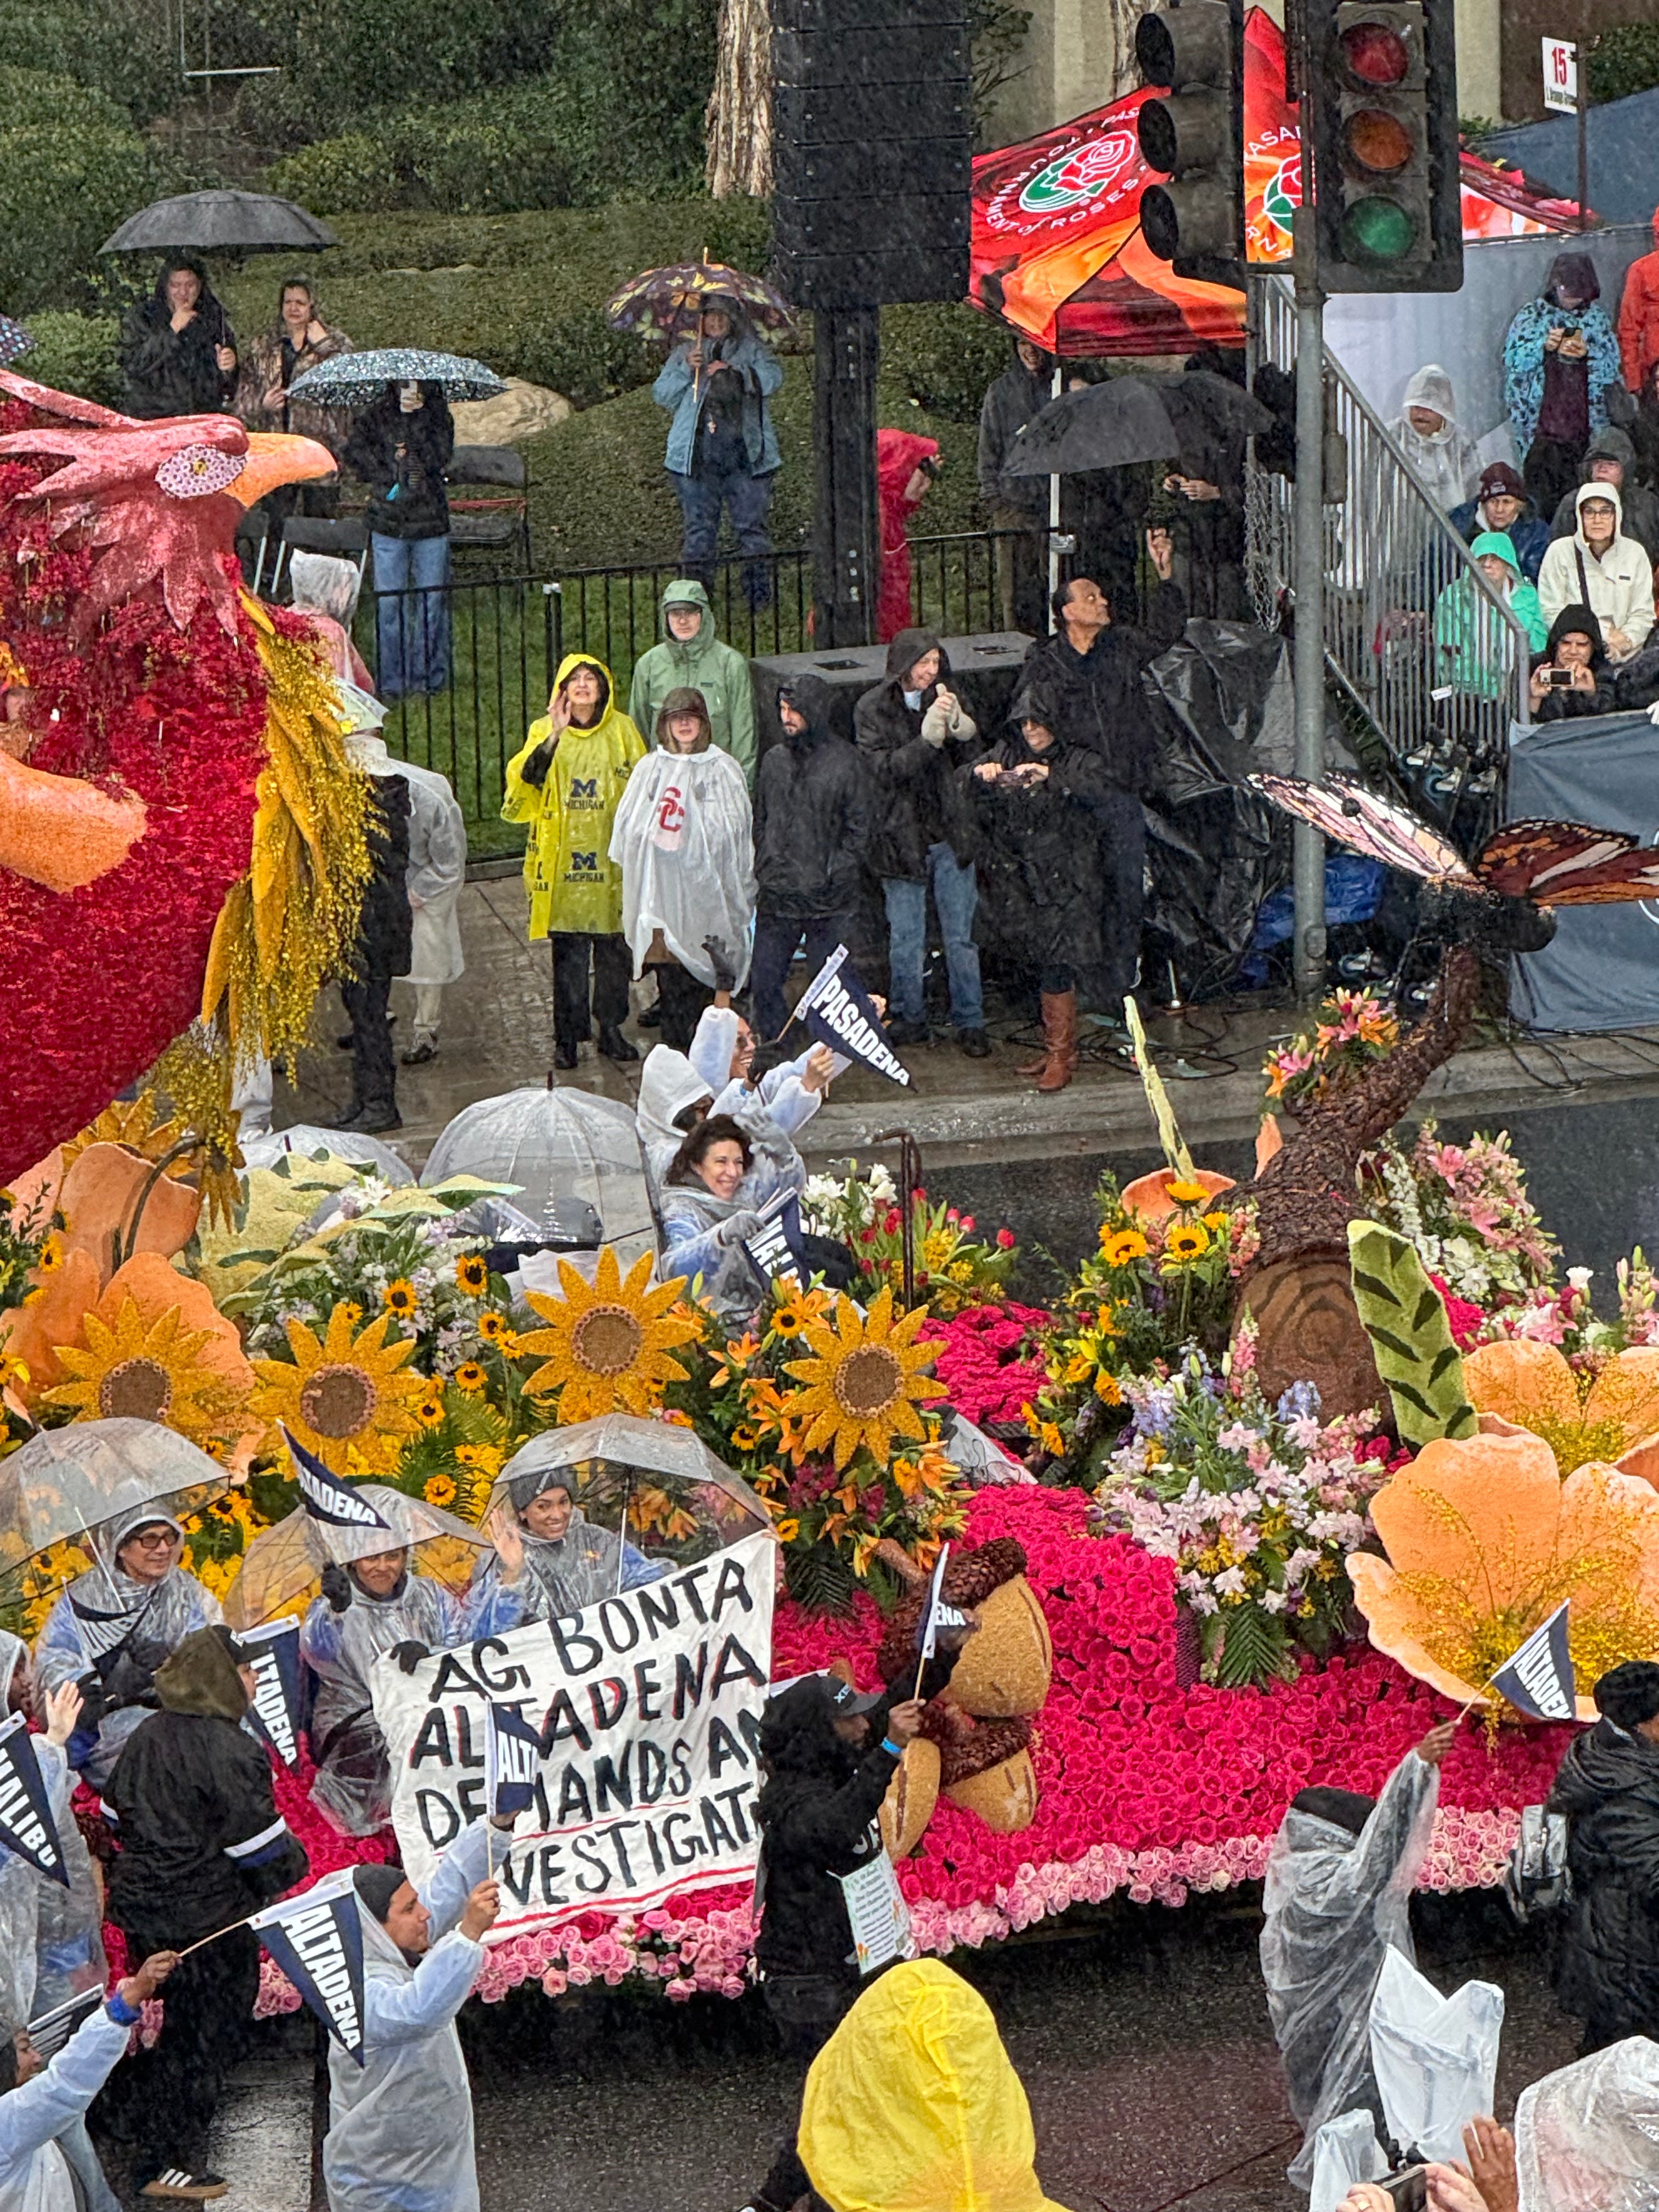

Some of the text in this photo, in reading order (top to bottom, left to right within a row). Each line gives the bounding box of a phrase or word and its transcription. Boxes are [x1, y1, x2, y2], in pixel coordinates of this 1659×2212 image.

[1551, 47, 1567, 86] 15
[1244, 126, 1301, 165] ASA
[986, 137, 1138, 236] TOURNAMENT of ROSES
[564, 798, 605, 810] MICHIGAN
[571, 778, 597, 798] M
[564, 872, 605, 883] MICHIGAN
[571, 851, 597, 870] M
[811, 974, 910, 1086] PASADENA
[428, 1558, 753, 1702] AG BONTA
[249, 1651, 297, 1766] LTADENA
[503, 1781, 760, 1905] VESTIGAT
[280, 1904, 361, 2051] ALTADENA
